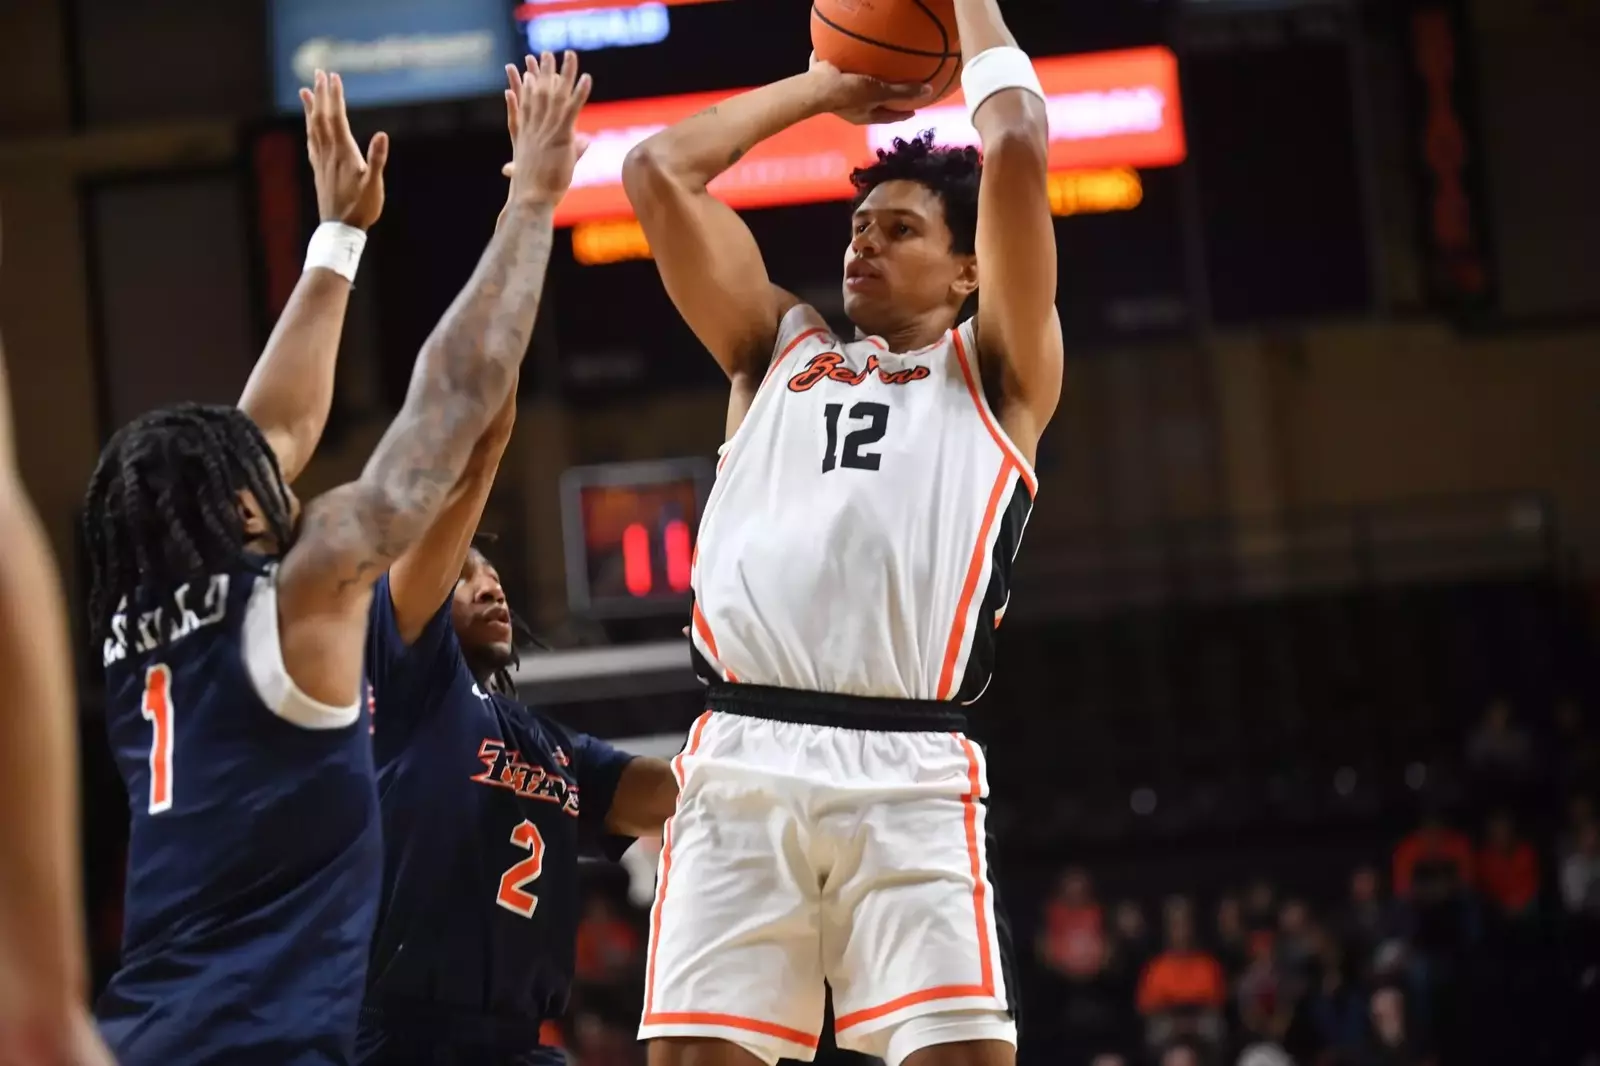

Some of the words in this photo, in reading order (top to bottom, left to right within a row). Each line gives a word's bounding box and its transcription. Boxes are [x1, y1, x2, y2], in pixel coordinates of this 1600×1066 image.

[822, 401, 890, 474] 12
[141, 663, 174, 815] 1
[496, 818, 546, 919] 2
